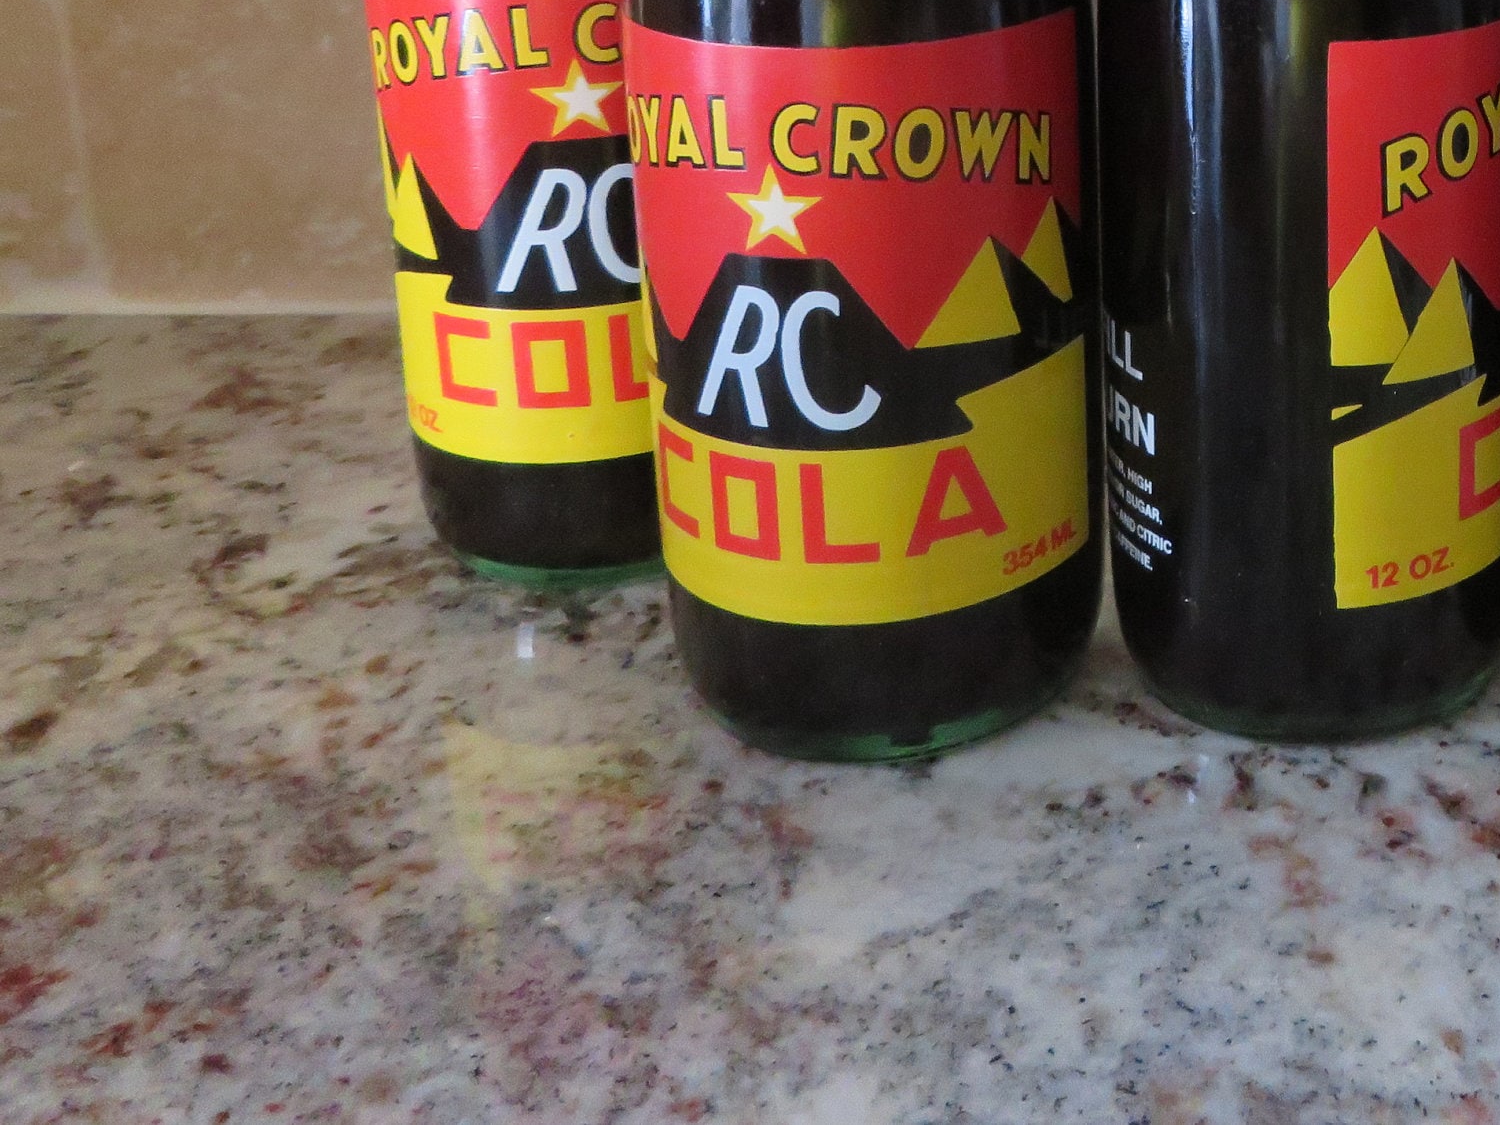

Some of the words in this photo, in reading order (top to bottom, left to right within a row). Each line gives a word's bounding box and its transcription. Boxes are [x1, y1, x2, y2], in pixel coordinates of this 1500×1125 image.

[370, 4, 551, 92] ROYAL
[770, 102, 1053, 184] CROWN
[697, 283, 883, 433] RC
[659, 421, 1008, 565] COLA
[1365, 561, 1399, 589] 12
[1409, 546, 1454, 579] OZ.
